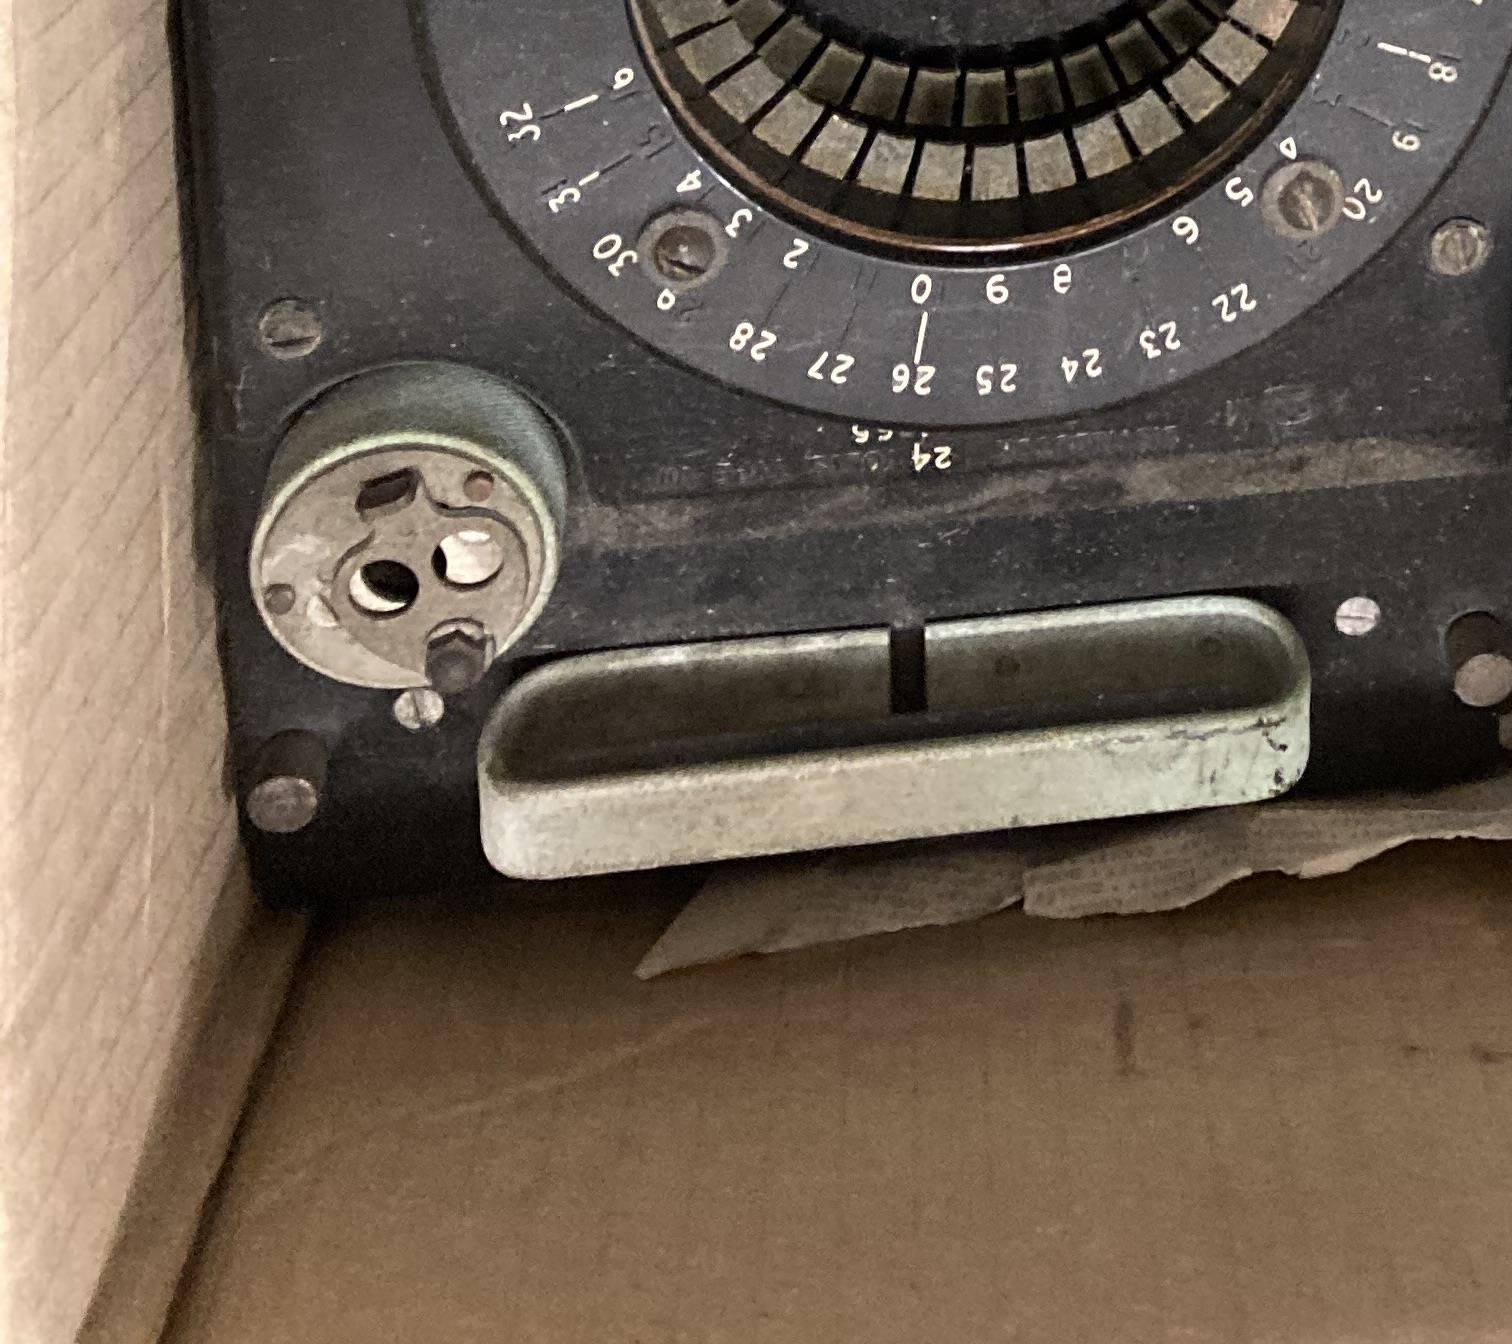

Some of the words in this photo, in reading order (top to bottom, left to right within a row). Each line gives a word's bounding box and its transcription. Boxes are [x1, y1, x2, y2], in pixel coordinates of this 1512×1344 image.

[500, 101, 542, 142] 32
[1225, 176, 1254, 208] 5
[1341, 177, 1383, 221] 20
[1172, 215, 1200, 245] 6
[593, 233, 639, 278] 30
[986, 273, 1009, 305] 9
[1212, 283, 1257, 322] 22
[730, 322, 776, 363] 28
[1140, 320, 1181, 359] 23
[808, 350, 855, 385] 27
[893, 363, 937, 396] 26
[976, 363, 1018, 396] 25
[1061, 347, 1103, 384] 24
[912, 443, 952, 472] 24
